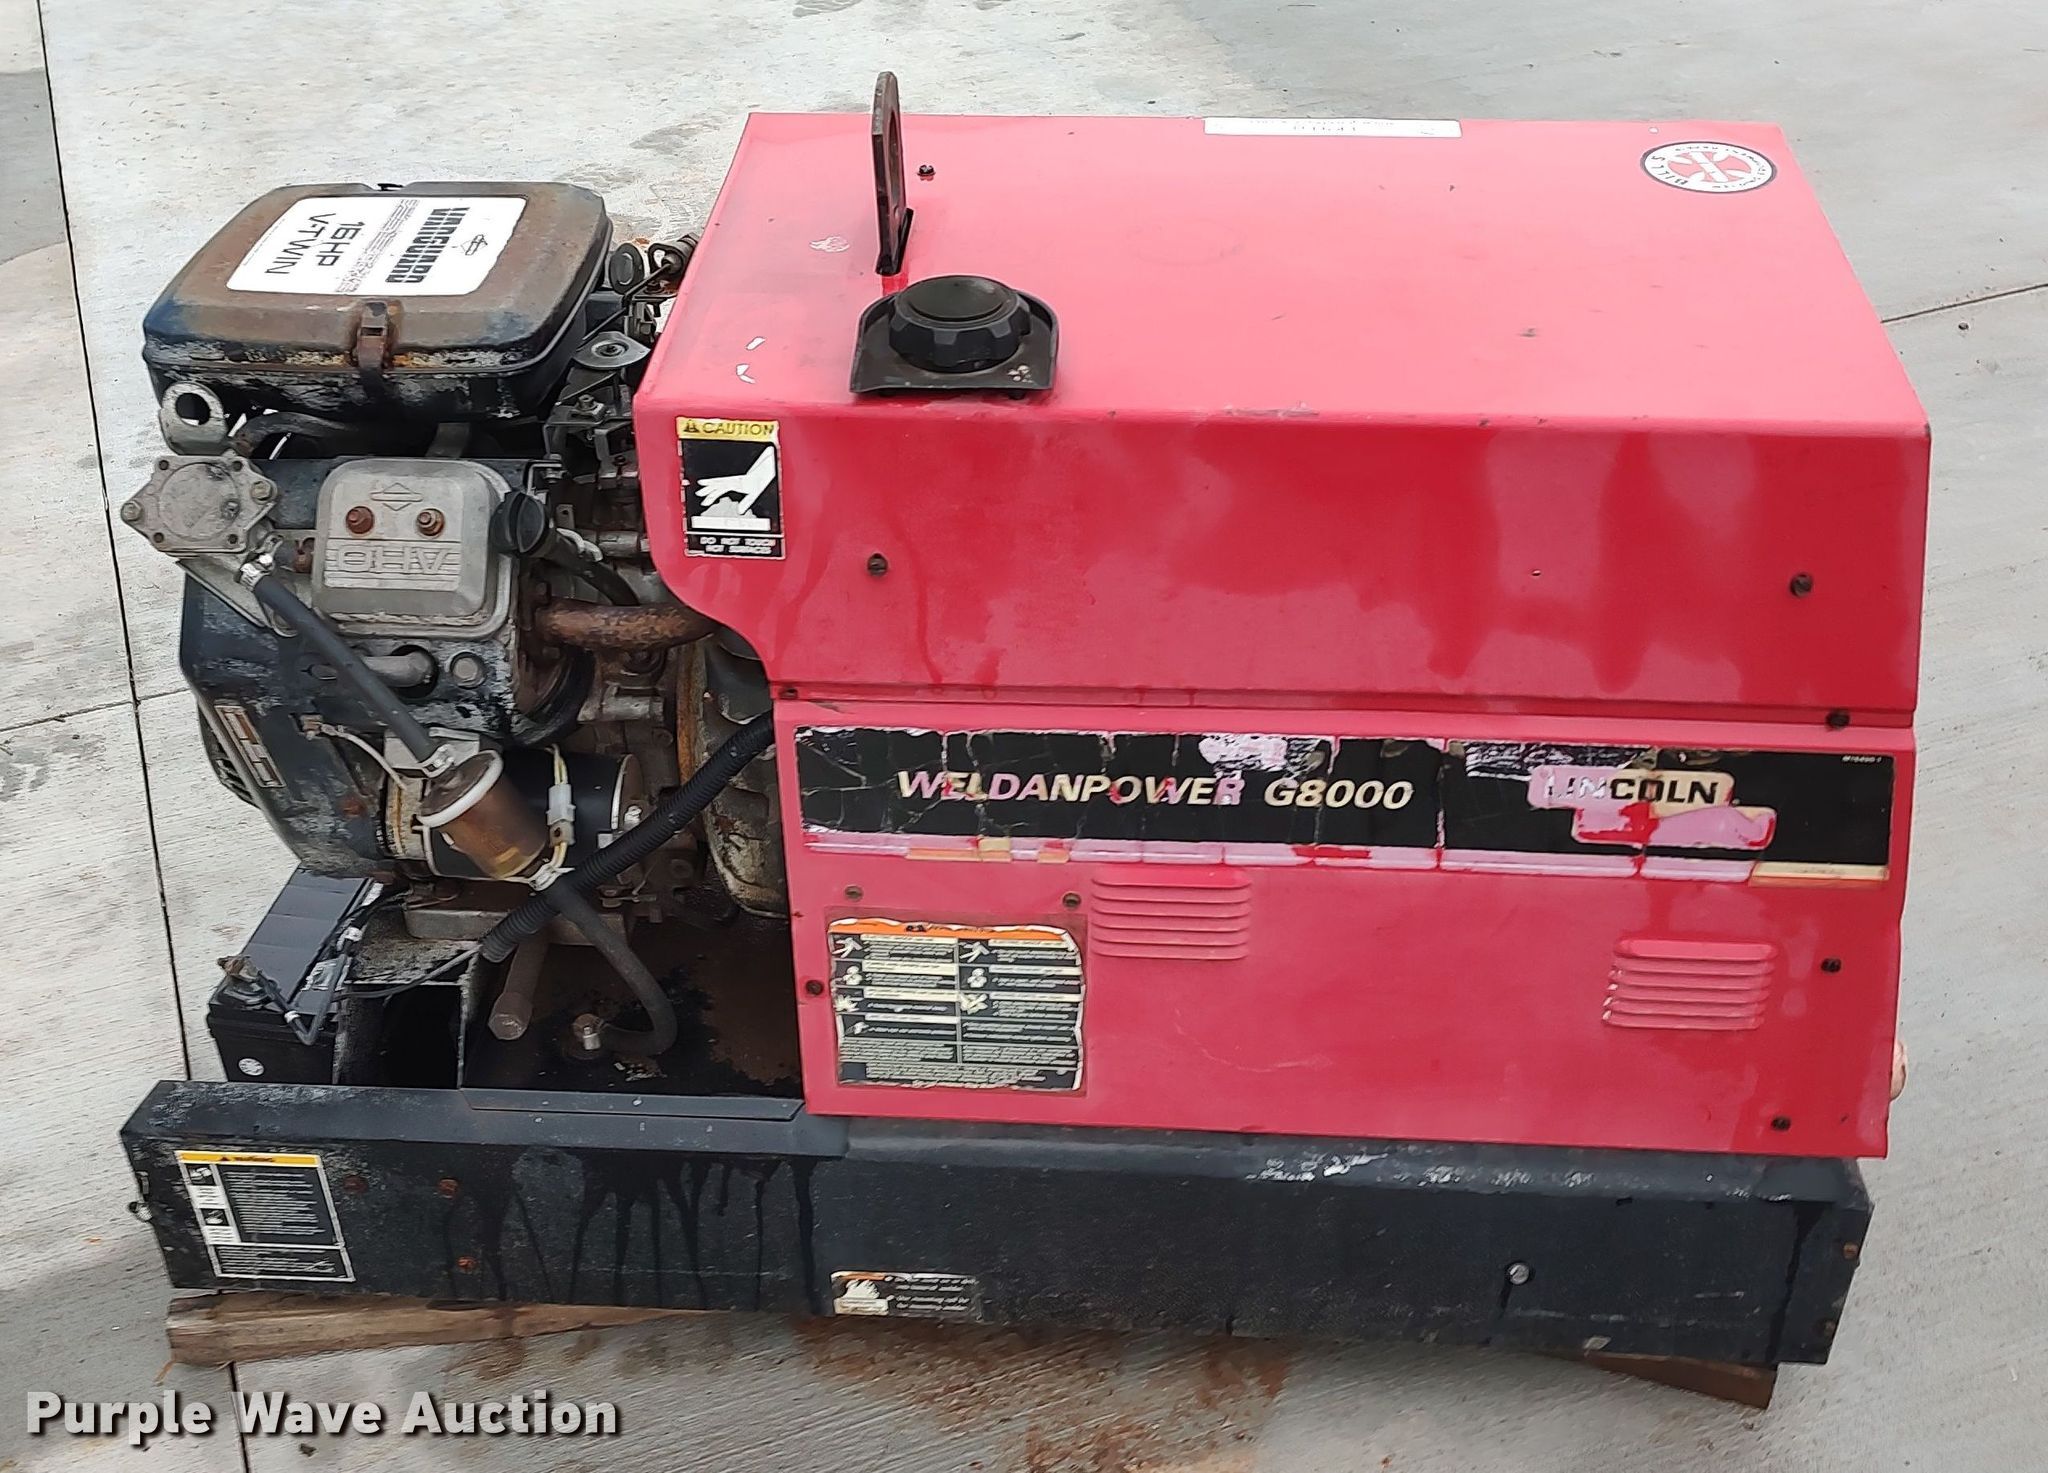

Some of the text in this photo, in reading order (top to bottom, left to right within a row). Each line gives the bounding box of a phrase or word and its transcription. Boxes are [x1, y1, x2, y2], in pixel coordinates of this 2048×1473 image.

[265, 212, 337, 275] V-TWIN
[385, 206, 471, 283] VANGUARD
[702, 422, 774, 436] CAUTION
[337, 545, 449, 574] OHV
[896, 769, 1416, 811] WELDANPOWER G8000
